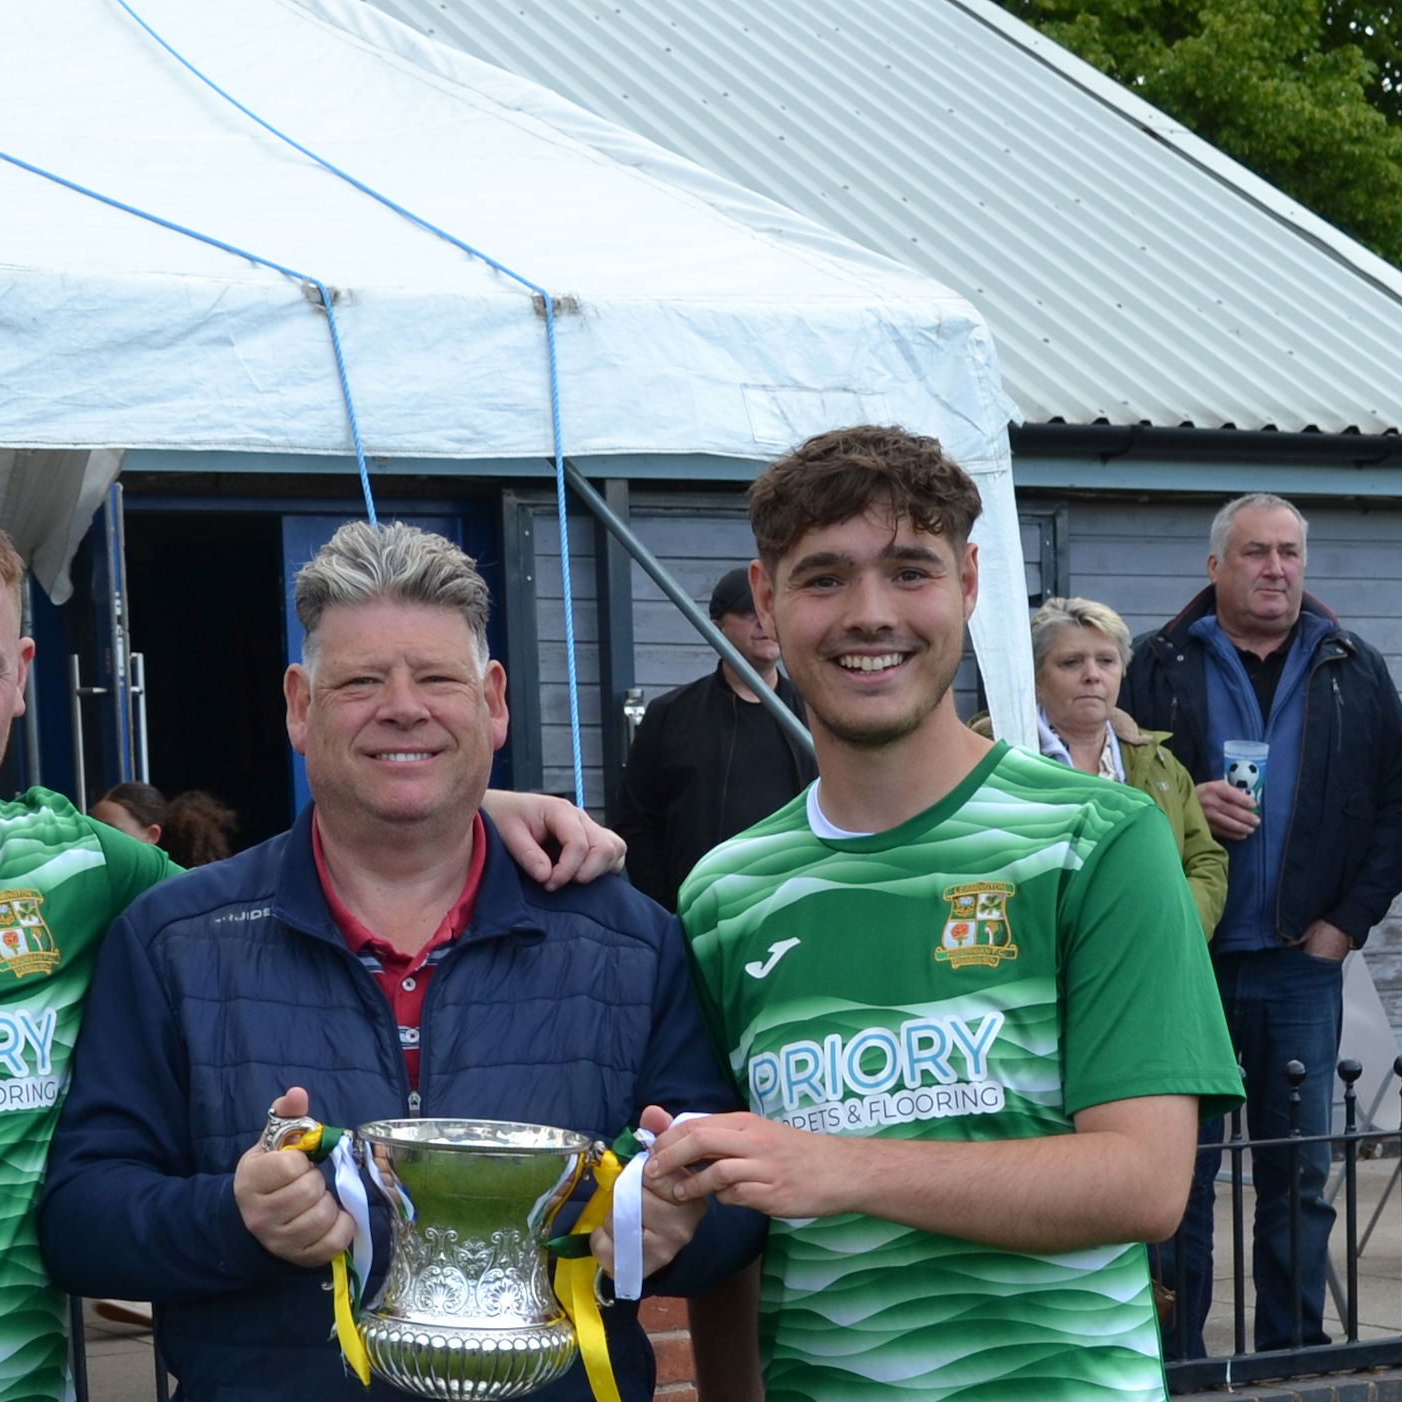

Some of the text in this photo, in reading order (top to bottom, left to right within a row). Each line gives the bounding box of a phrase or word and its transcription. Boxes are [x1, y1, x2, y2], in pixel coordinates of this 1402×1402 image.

[751, 1016, 999, 1115] PRIORY
[847, 1104, 862, 1124] &
[869, 1086, 999, 1121] FLOORING
